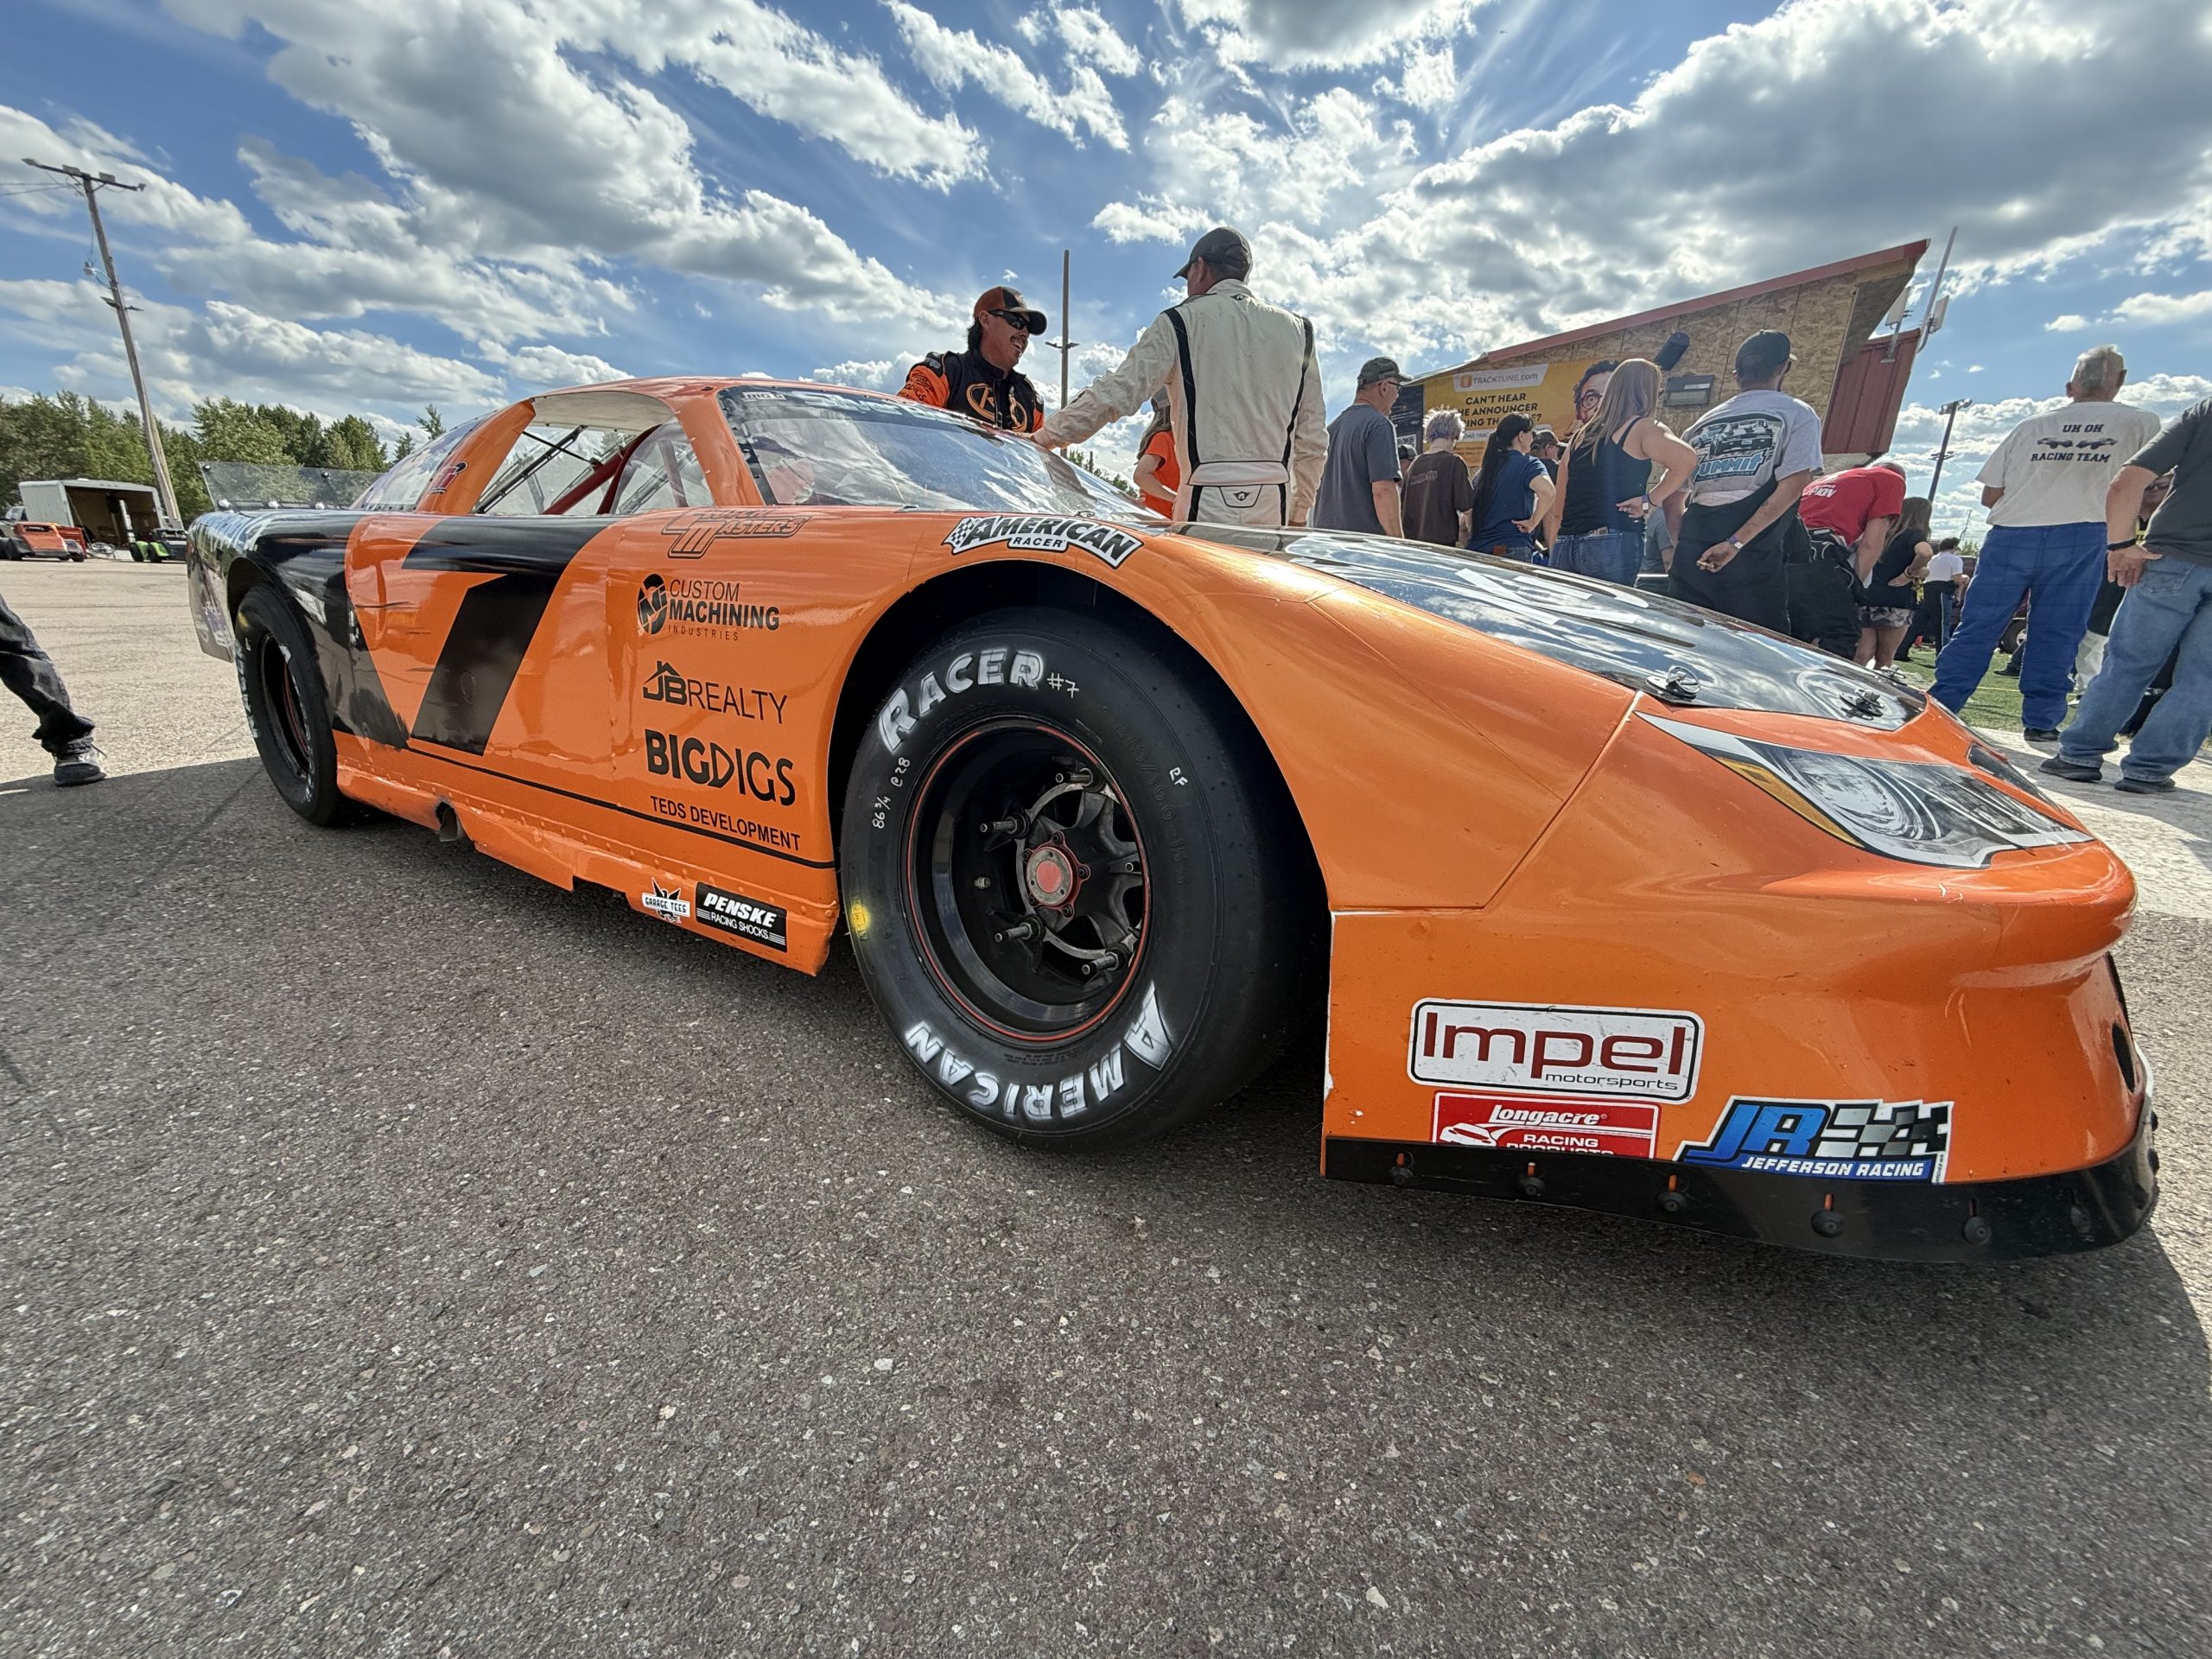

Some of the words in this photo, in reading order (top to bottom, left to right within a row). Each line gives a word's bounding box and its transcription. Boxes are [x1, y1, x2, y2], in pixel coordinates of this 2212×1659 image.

[1472, 372, 1538, 385] TRACKTUNE.com
[1465, 395, 1497, 405] CAN'T
[1498, 392, 1526, 403] HEAR
[1458, 408, 1470, 416] HE
[1471, 403, 1538, 416] ANNOUNCER
[1487, 417, 1500, 426] TH
[2063, 424, 2082, 433] UH
[2084, 423, 2105, 433] OH
[2031, 452, 2075, 462] RACING
[2076, 453, 2112, 463] TEAM
[963, 515, 1137, 562] AMERICAN
[1012, 537, 1065, 550] RACER
[670, 578, 741, 602] CUSTOM
[669, 598, 779, 631] MACHINING
[668, 625, 740, 642] INDUSTRIES
[1046, 671, 1080, 699] #7
[876, 648, 1045, 753] RACER
[1169, 766, 1189, 787] RF
[650, 796, 686, 819] TEDS
[690, 806, 801, 851] DEVELOPMENT
[645, 897, 668, 910] GARAGE
[671, 901, 687, 913] TEES
[703, 893, 778, 928] PENSKE
[710, 912, 738, 930] RACING
[738, 921, 769, 940] SHOCKS
[905, 980, 1177, 1121] AMERICAN
[1422, 1012, 1687, 1079] Impel
[1545, 1072, 1678, 1090] motorsports
[1522, 1133, 1599, 1148] RACING
[1741, 1156, 1856, 1176] JEFFERSON
[1855, 1163, 1925, 1177] RACING
